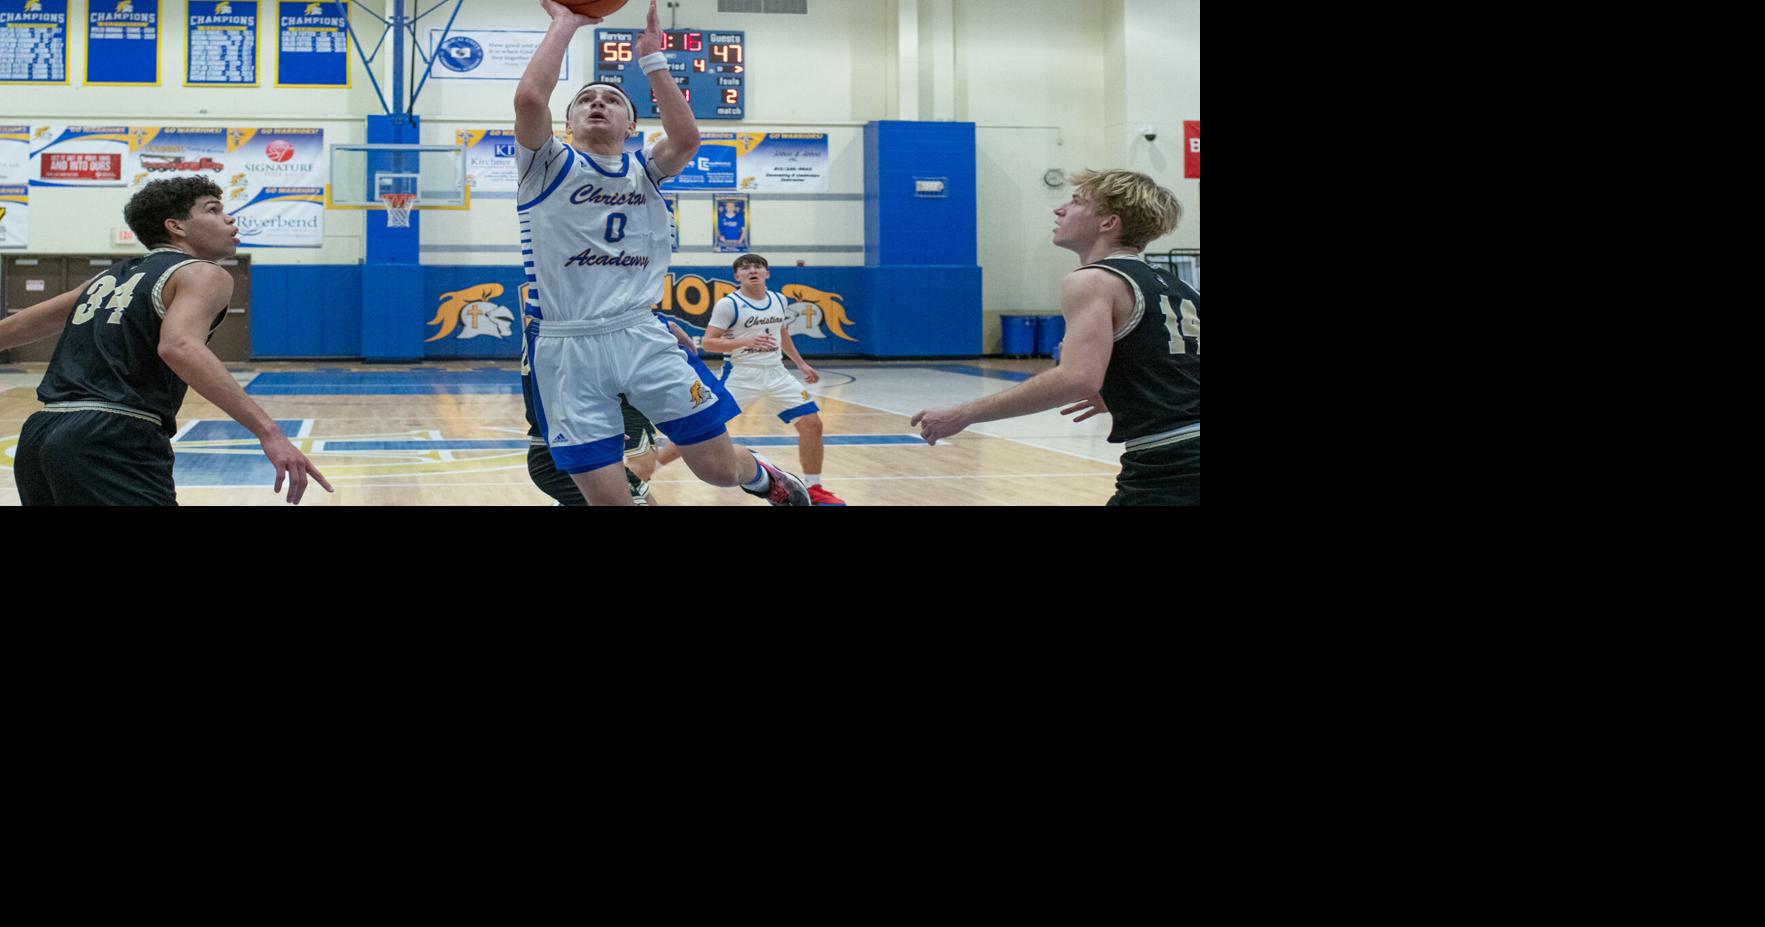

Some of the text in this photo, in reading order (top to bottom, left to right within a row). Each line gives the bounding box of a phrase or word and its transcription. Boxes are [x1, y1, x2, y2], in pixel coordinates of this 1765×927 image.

[0, 13, 65, 24] CHAMPIONS
[90, 12, 156, 23] CHAMPIONS
[190, 15, 255, 26] CHAMPIONS
[281, 16, 345, 27] CHAMPIONS
[599, 32, 633, 41] Warriors
[710, 33, 741, 43] Guests
[603, 42, 633, 62] 56
[713, 44, 742, 63] 47
[693, 59, 706, 72] 4
[600, 76, 622, 84] fouls
[719, 77, 740, 86] fouls
[725, 89, 738, 104] 2
[717, 107, 742, 115] match
[50, 160, 68, 171] AND
[245, 163, 313, 172] SIGNATURE
[237, 215, 318, 229] Riverbend
[604, 212, 628, 243] 0
[564, 248, 650, 272] Academy
[72, 272, 147, 325] 34
